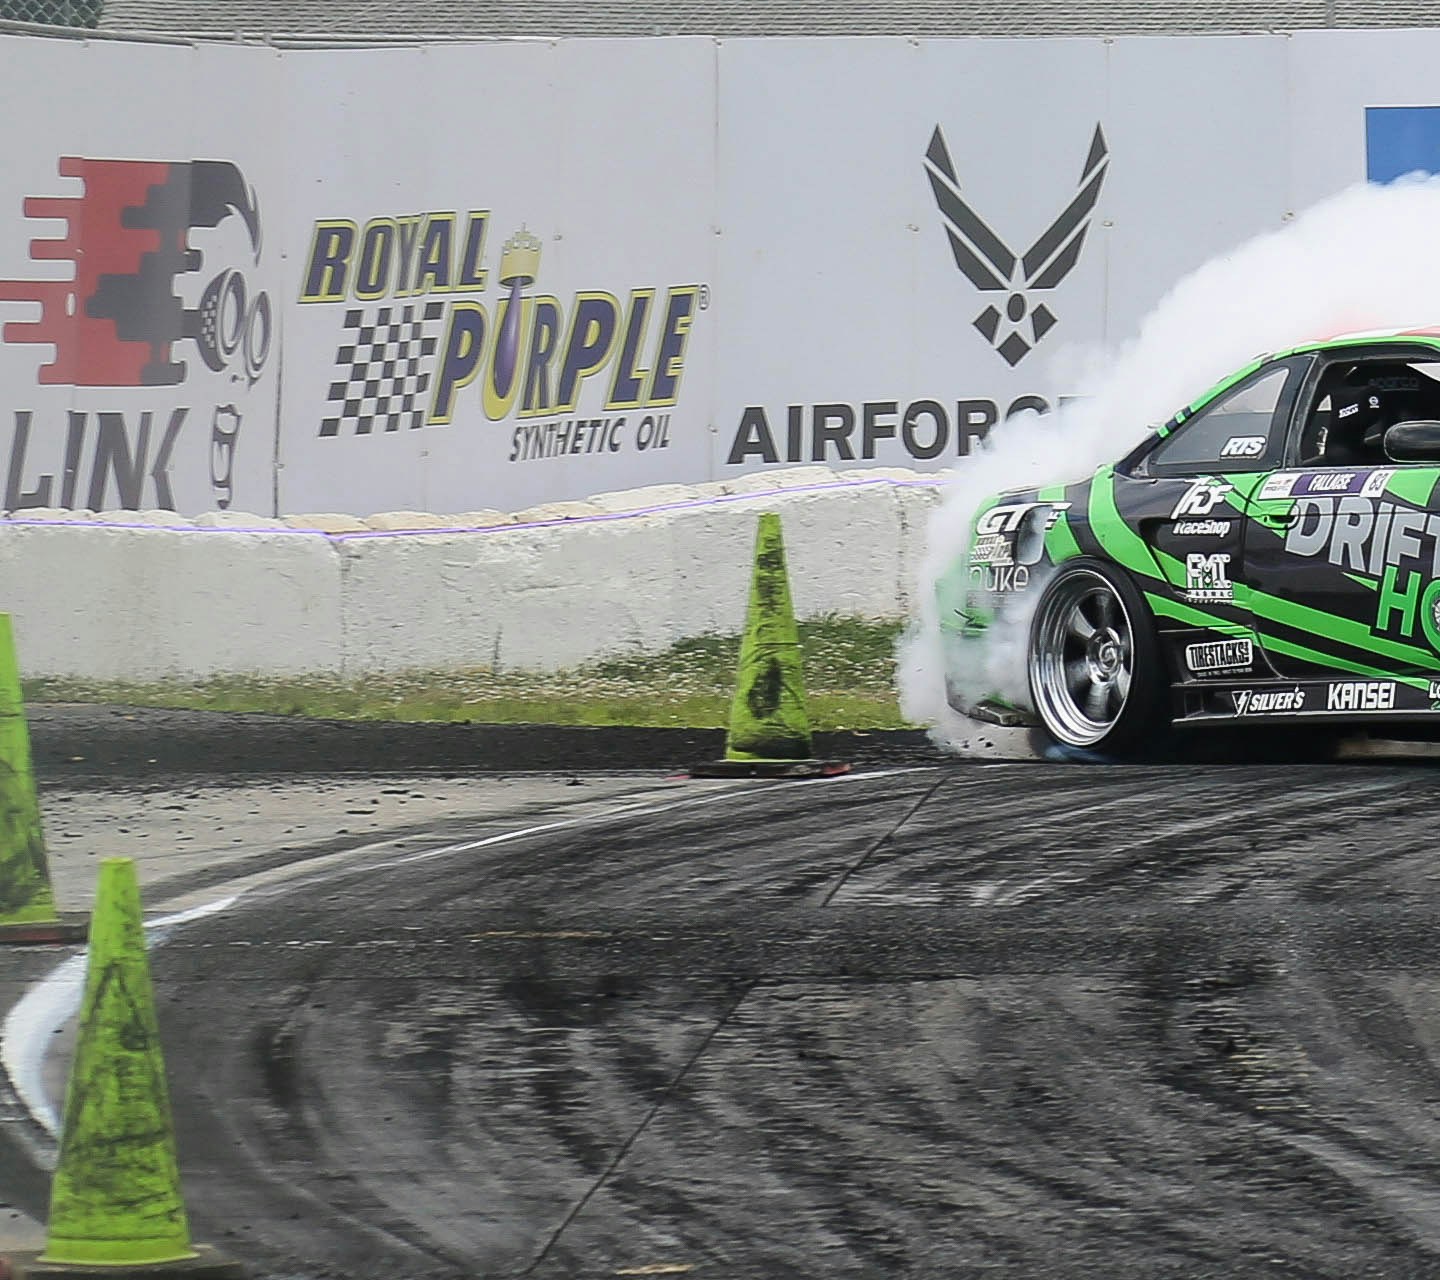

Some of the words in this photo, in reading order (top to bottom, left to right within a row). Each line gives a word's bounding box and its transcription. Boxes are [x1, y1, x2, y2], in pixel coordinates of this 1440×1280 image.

[297, 209, 492, 304] ROYAL
[425, 284, 700, 425] PURPLE
[510, 418, 622, 462] SYNTHETIC
[636, 414, 672, 451] OIL
[727, 394, 1094, 465] AIRFOR
[4, 407, 191, 513] LINK
[976, 502, 1073, 535] GT
[968, 565, 1029, 592] nuke
[1327, 682, 1397, 710] KANSEI
